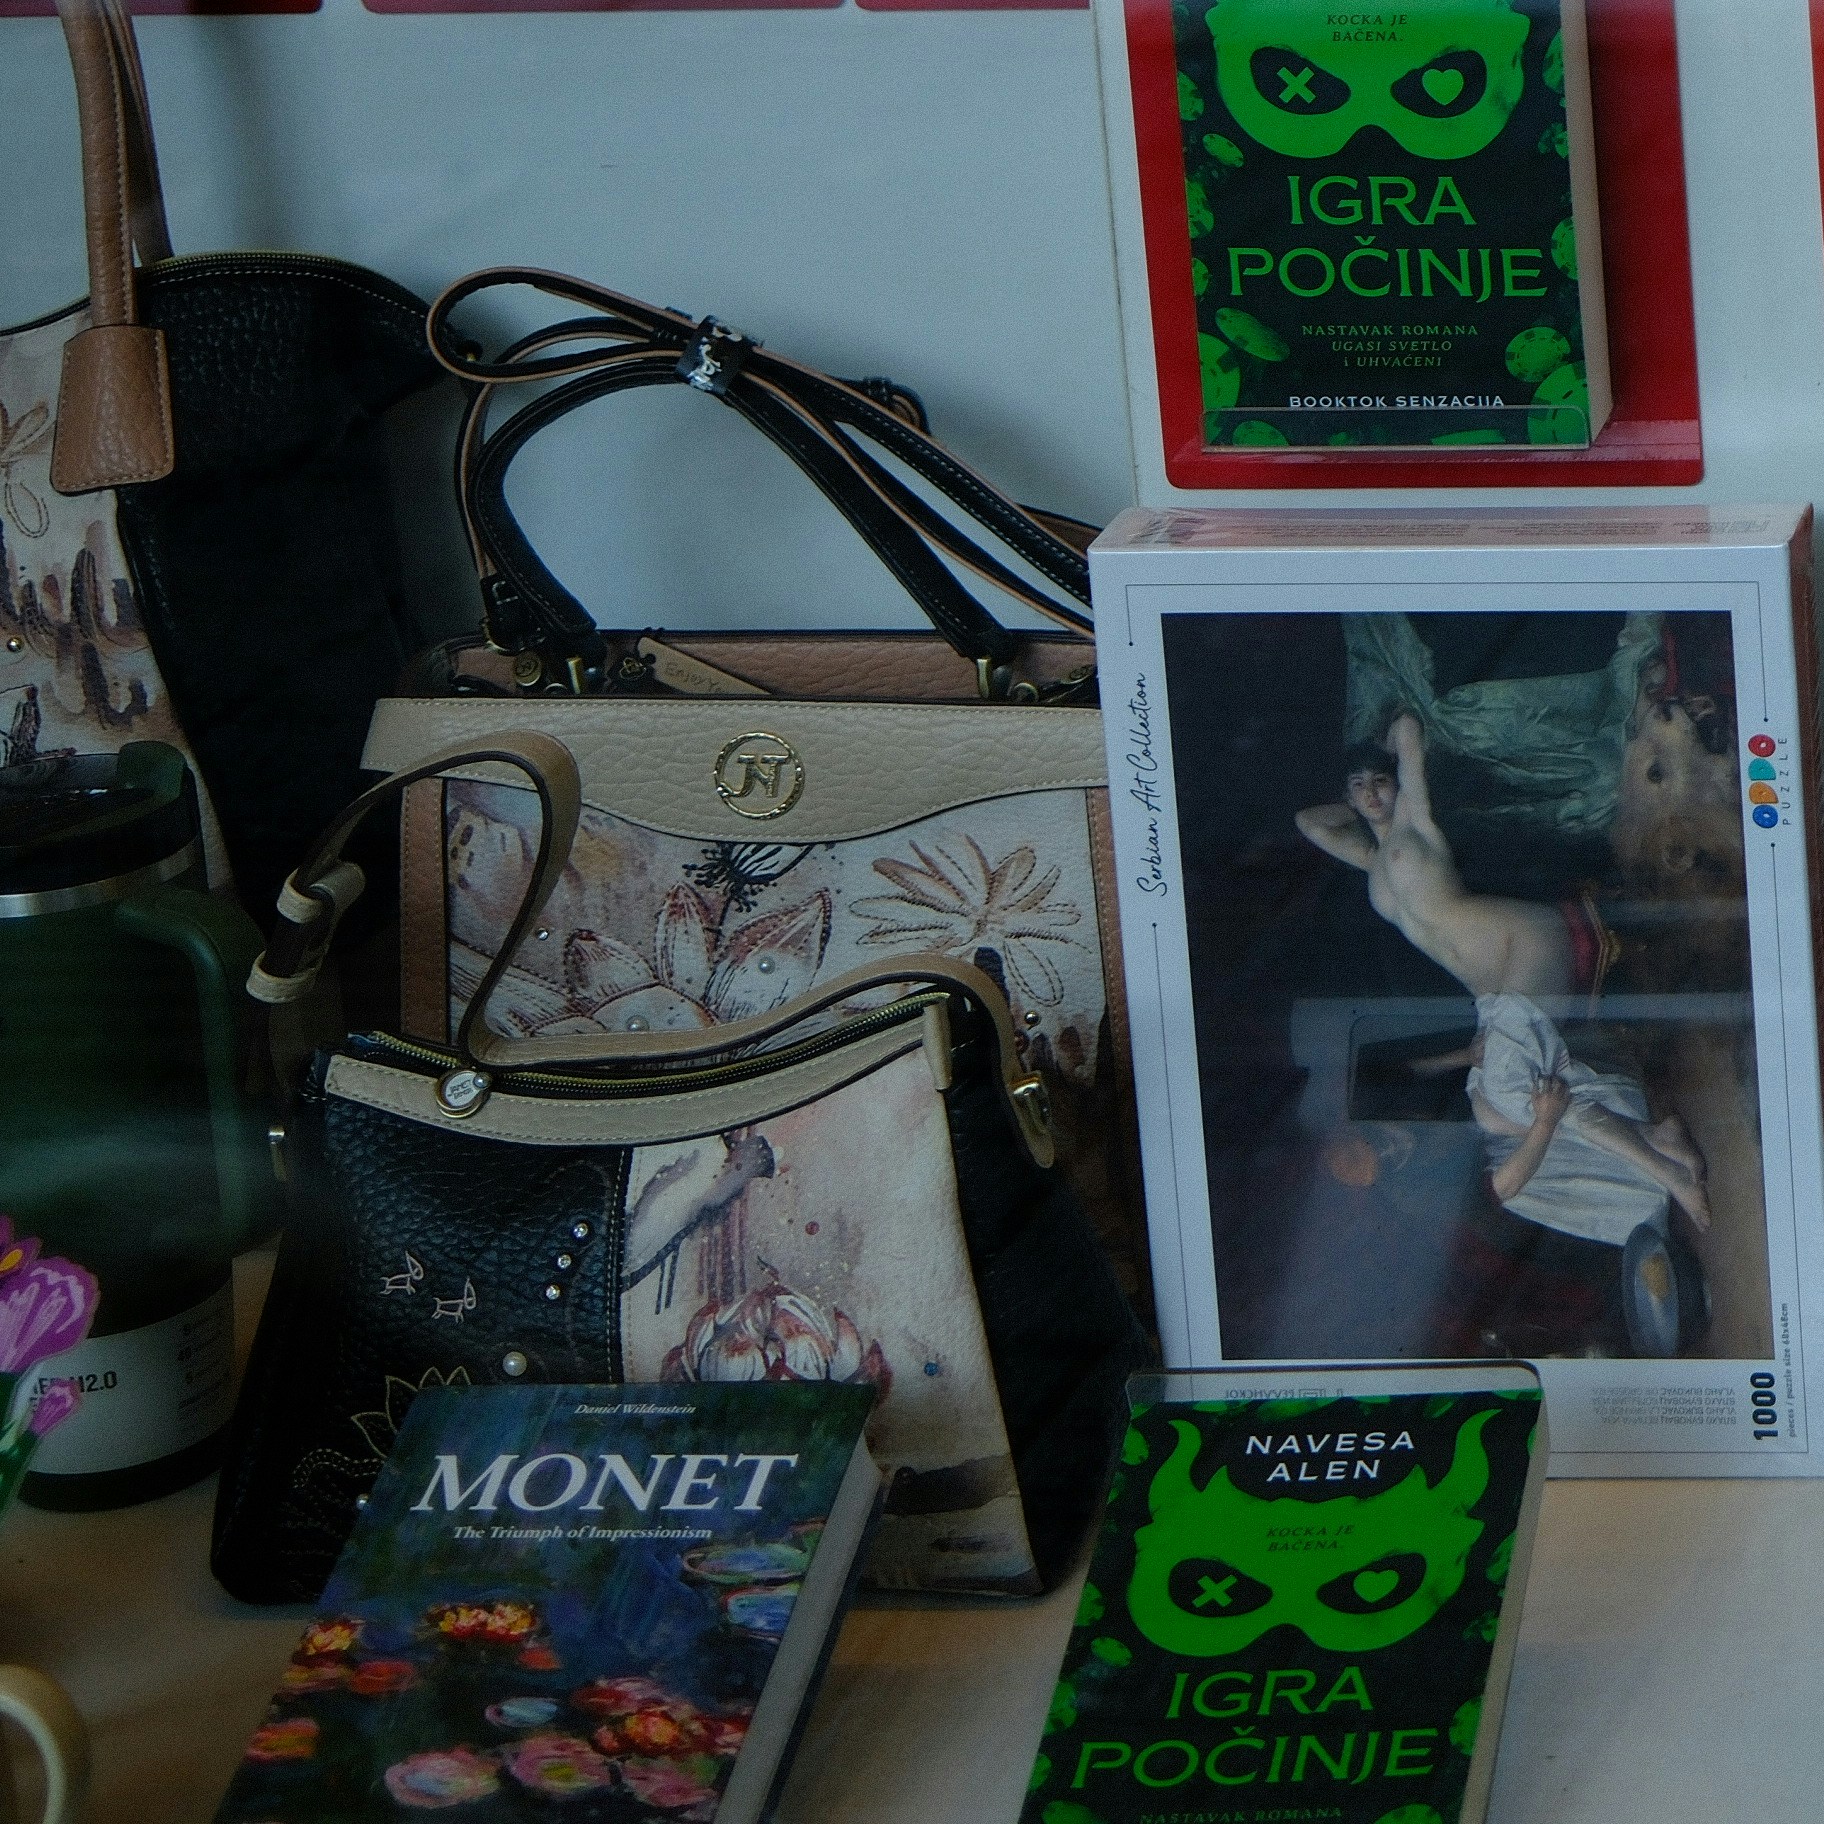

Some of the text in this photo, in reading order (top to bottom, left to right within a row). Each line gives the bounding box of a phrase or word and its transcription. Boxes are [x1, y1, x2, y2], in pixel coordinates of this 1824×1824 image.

[1289, 176, 1474, 226] IGRA
[1228, 236, 1546, 302] POČINJE
[1124, 667, 1168, 896] Serbian Art Collection
[574, 1403, 696, 1416] Daniel Wildenstein
[1752, 1372, 1779, 1442] 1000
[1246, 1431, 1415, 1455] NAVESA
[410, 1454, 799, 1512] MONET
[1267, 1460, 1380, 1482] ALEN
[453, 1524, 712, 1543] The Triumph of Impressionism
[1166, 1666, 1372, 1718] IGRA
[1072, 1726, 1438, 1788] POČINJE
